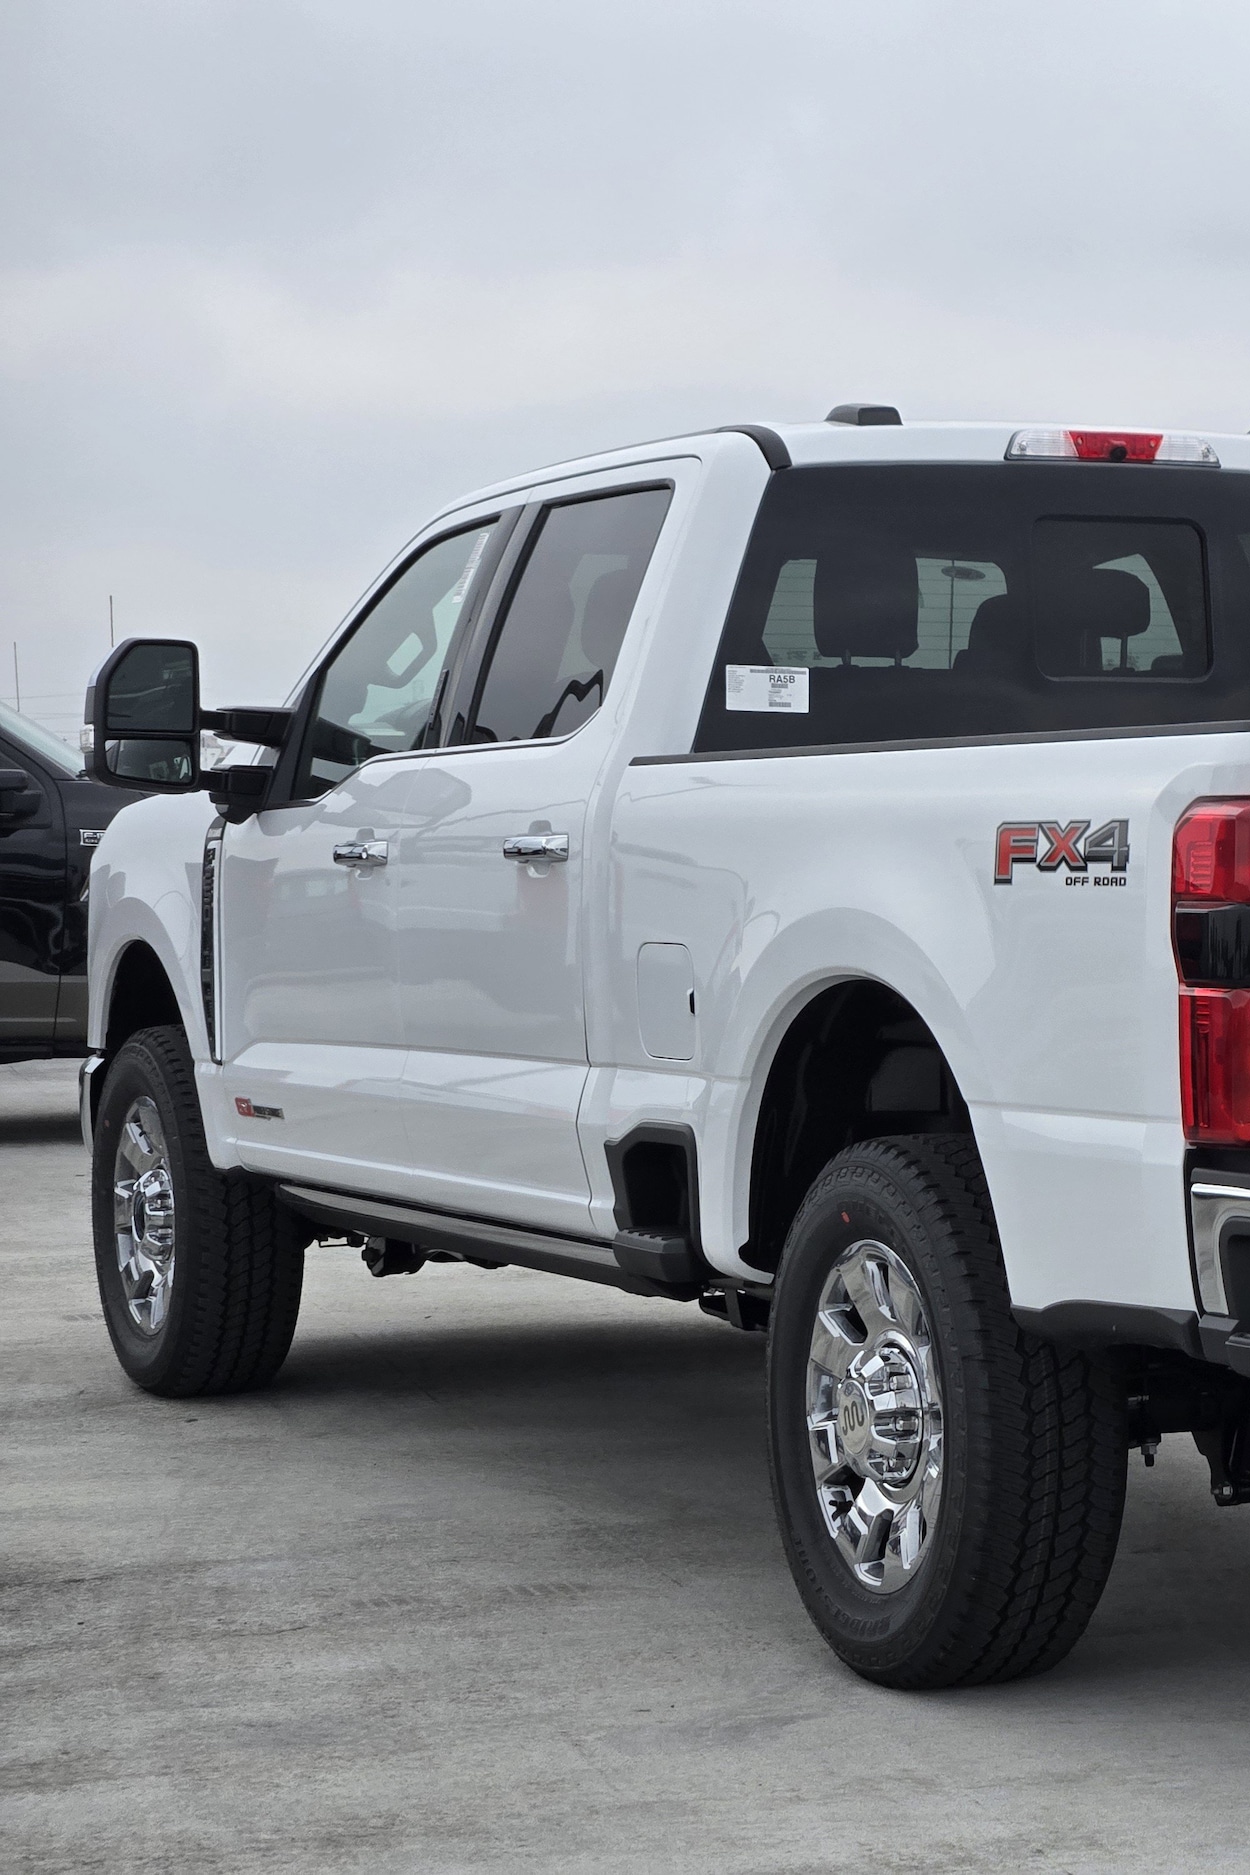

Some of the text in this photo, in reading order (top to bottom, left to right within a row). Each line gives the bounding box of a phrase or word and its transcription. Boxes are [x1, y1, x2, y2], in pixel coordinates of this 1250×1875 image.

[769, 674, 796, 684] RA5B
[994, 818, 1131, 885] FX4
[1065, 876, 1127, 887] OFF ROAD
